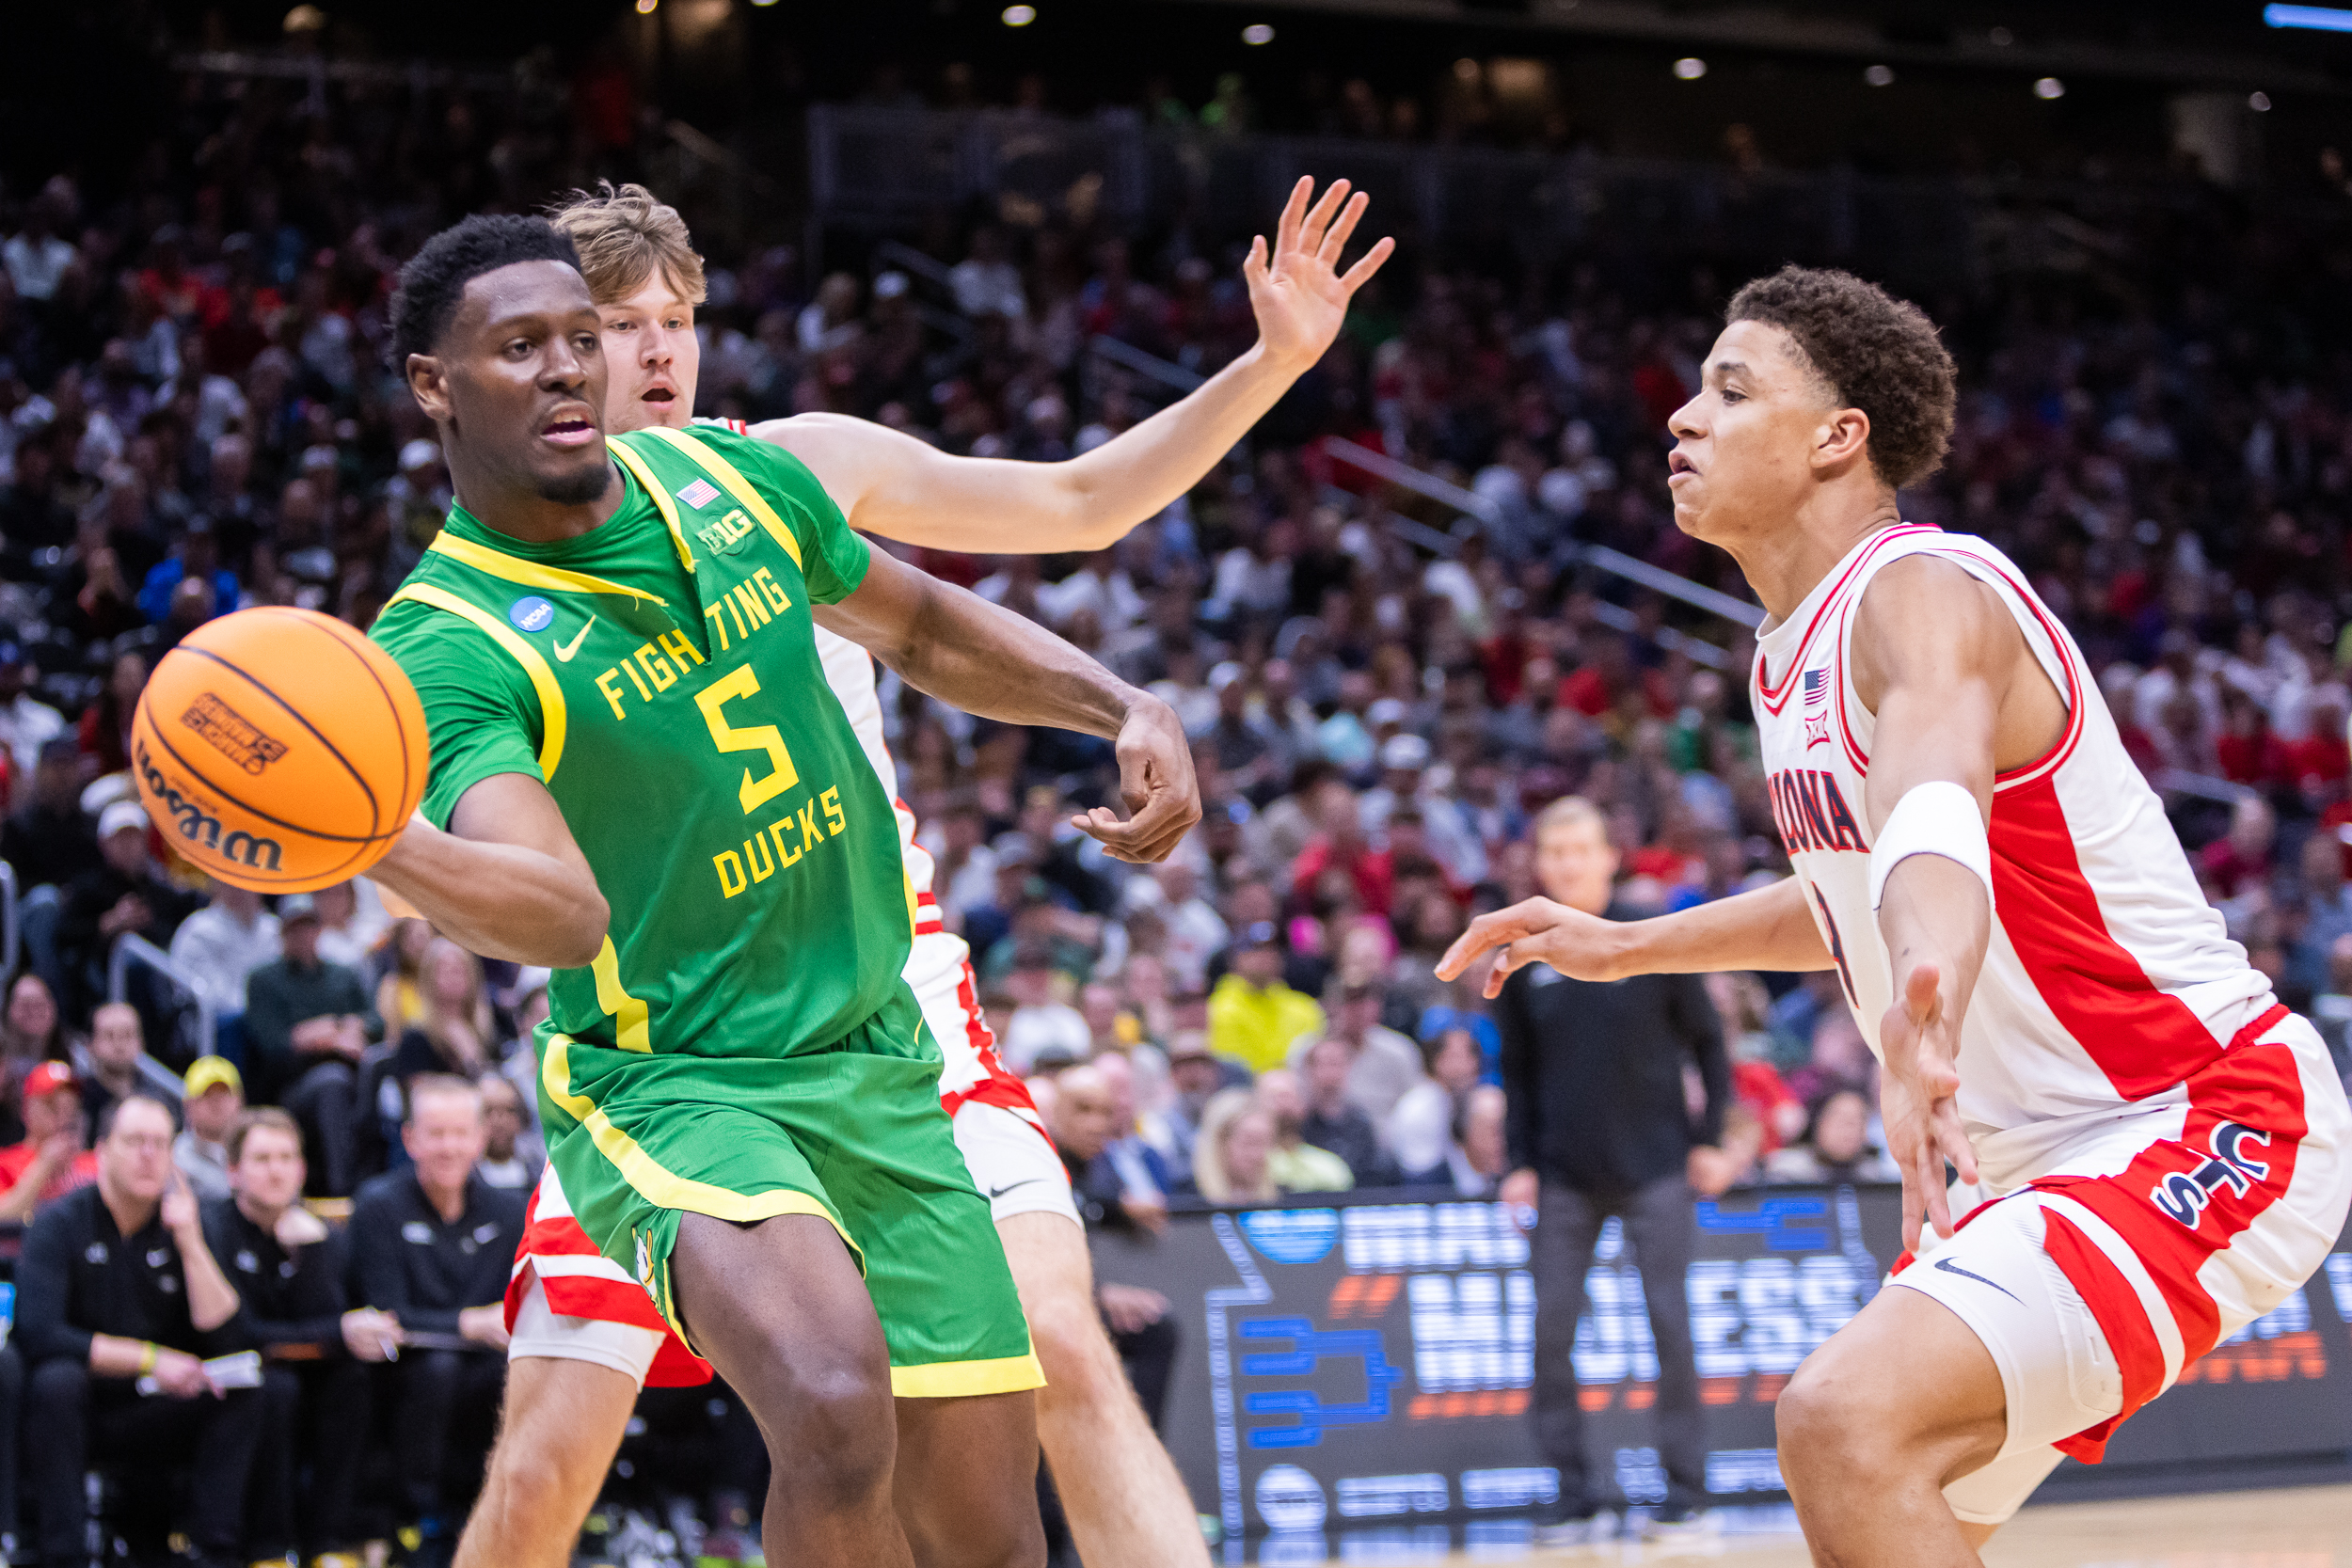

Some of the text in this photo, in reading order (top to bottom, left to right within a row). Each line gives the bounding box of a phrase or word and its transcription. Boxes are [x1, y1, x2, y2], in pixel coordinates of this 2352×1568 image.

[697, 509, 754, 556] BIG
[520, 603, 552, 629] NCAA
[693, 662, 799, 816] 5
[135, 737, 282, 872] Wilson
[712, 784, 846, 899] DUCKS
[1768, 768, 1871, 856] ZONA
[2149, 1119, 2271, 1231] CTS
